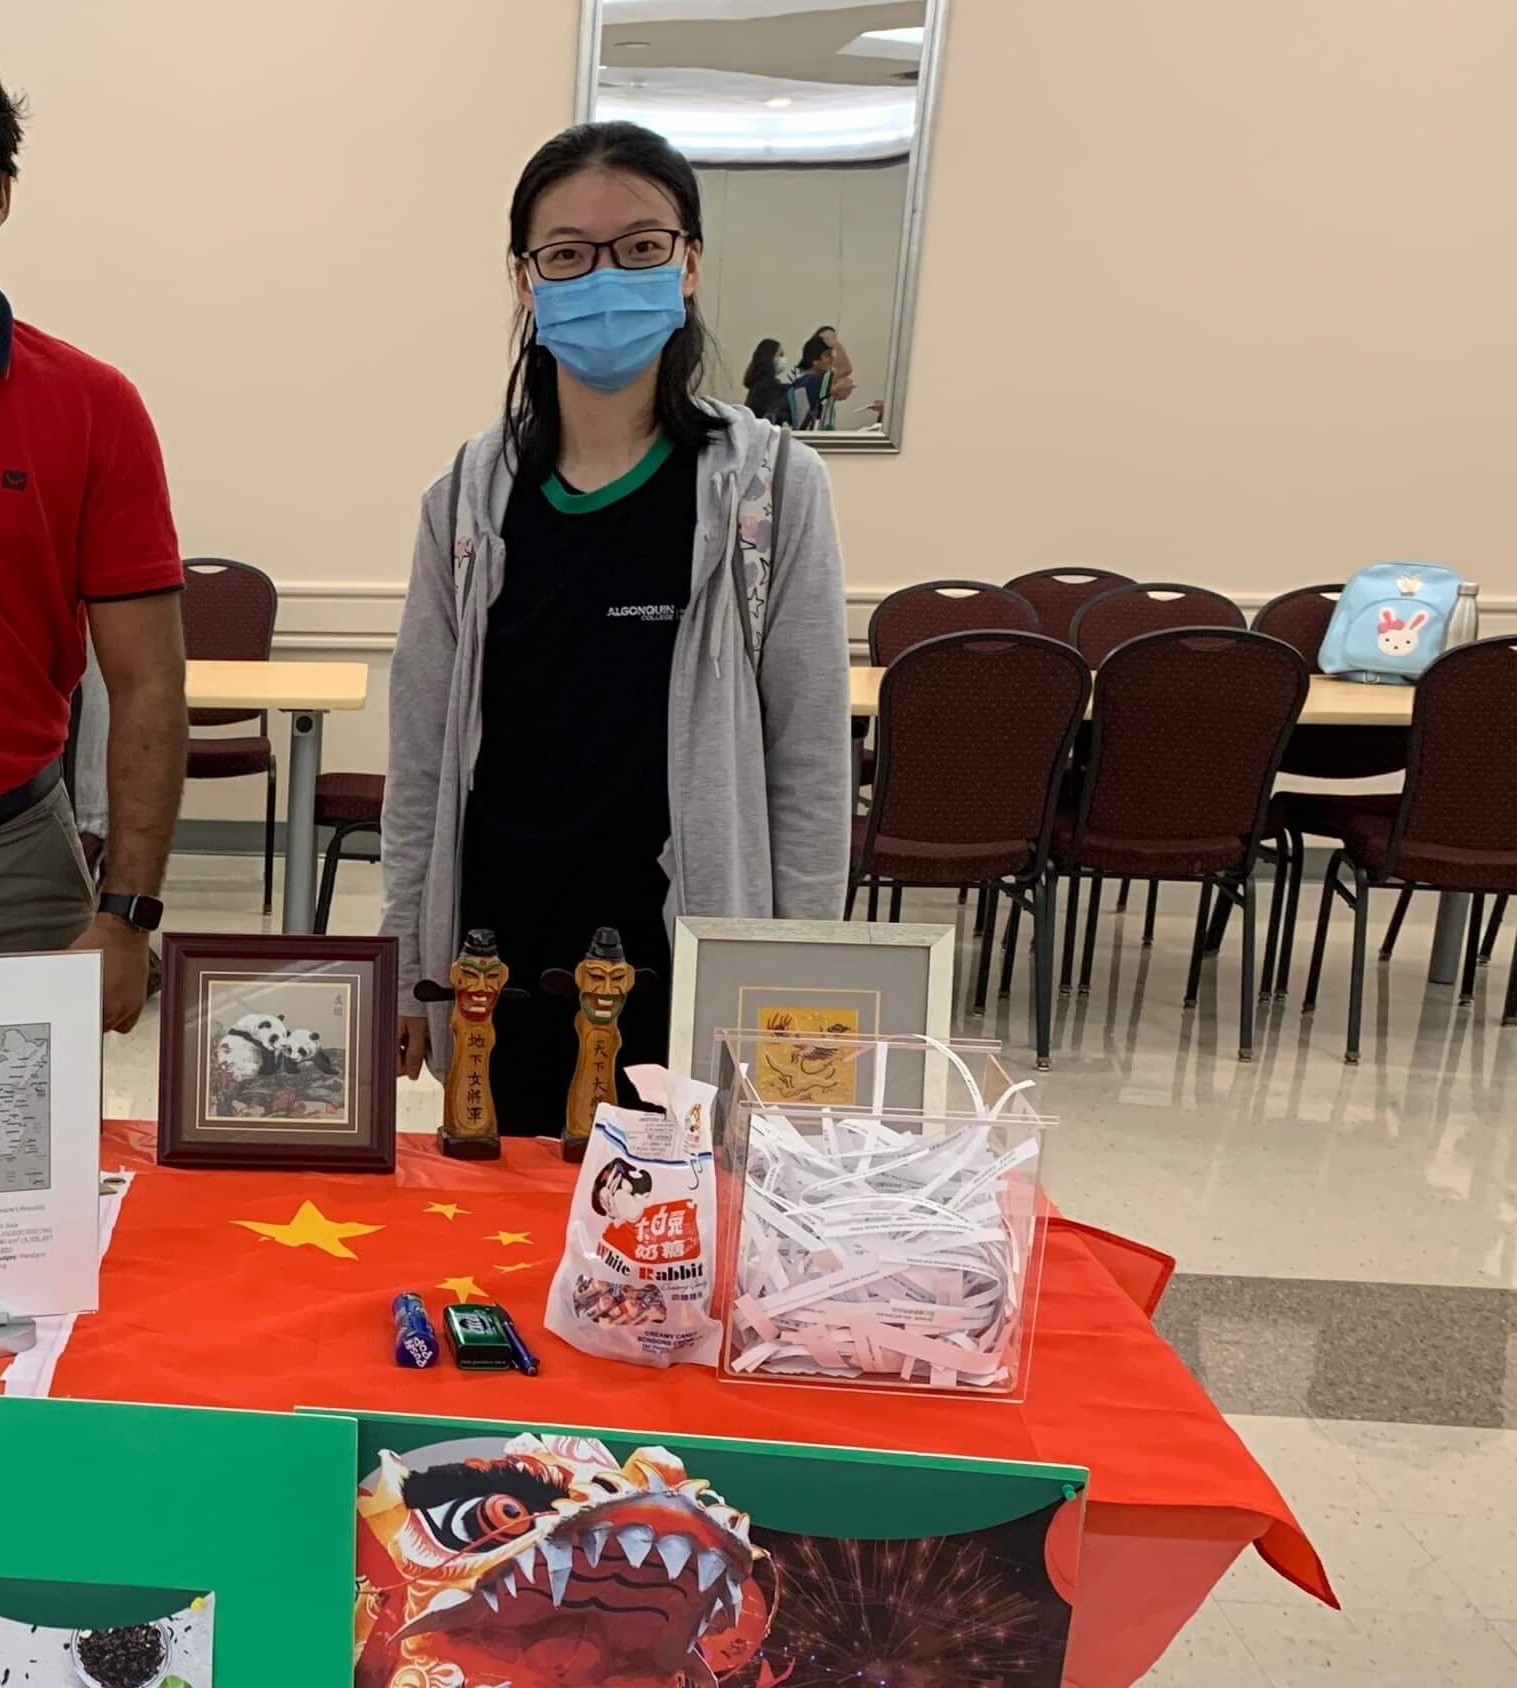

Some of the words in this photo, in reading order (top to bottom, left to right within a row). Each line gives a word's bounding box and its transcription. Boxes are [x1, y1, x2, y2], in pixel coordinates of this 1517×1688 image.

[607, 604, 675, 616] ALGONQUIN
[595, 1241, 631, 1277] White
[638, 1262, 703, 1281] Rabbit
[403, 1339, 428, 1368] PUSH
[413, 1336, 434, 1360] POP
